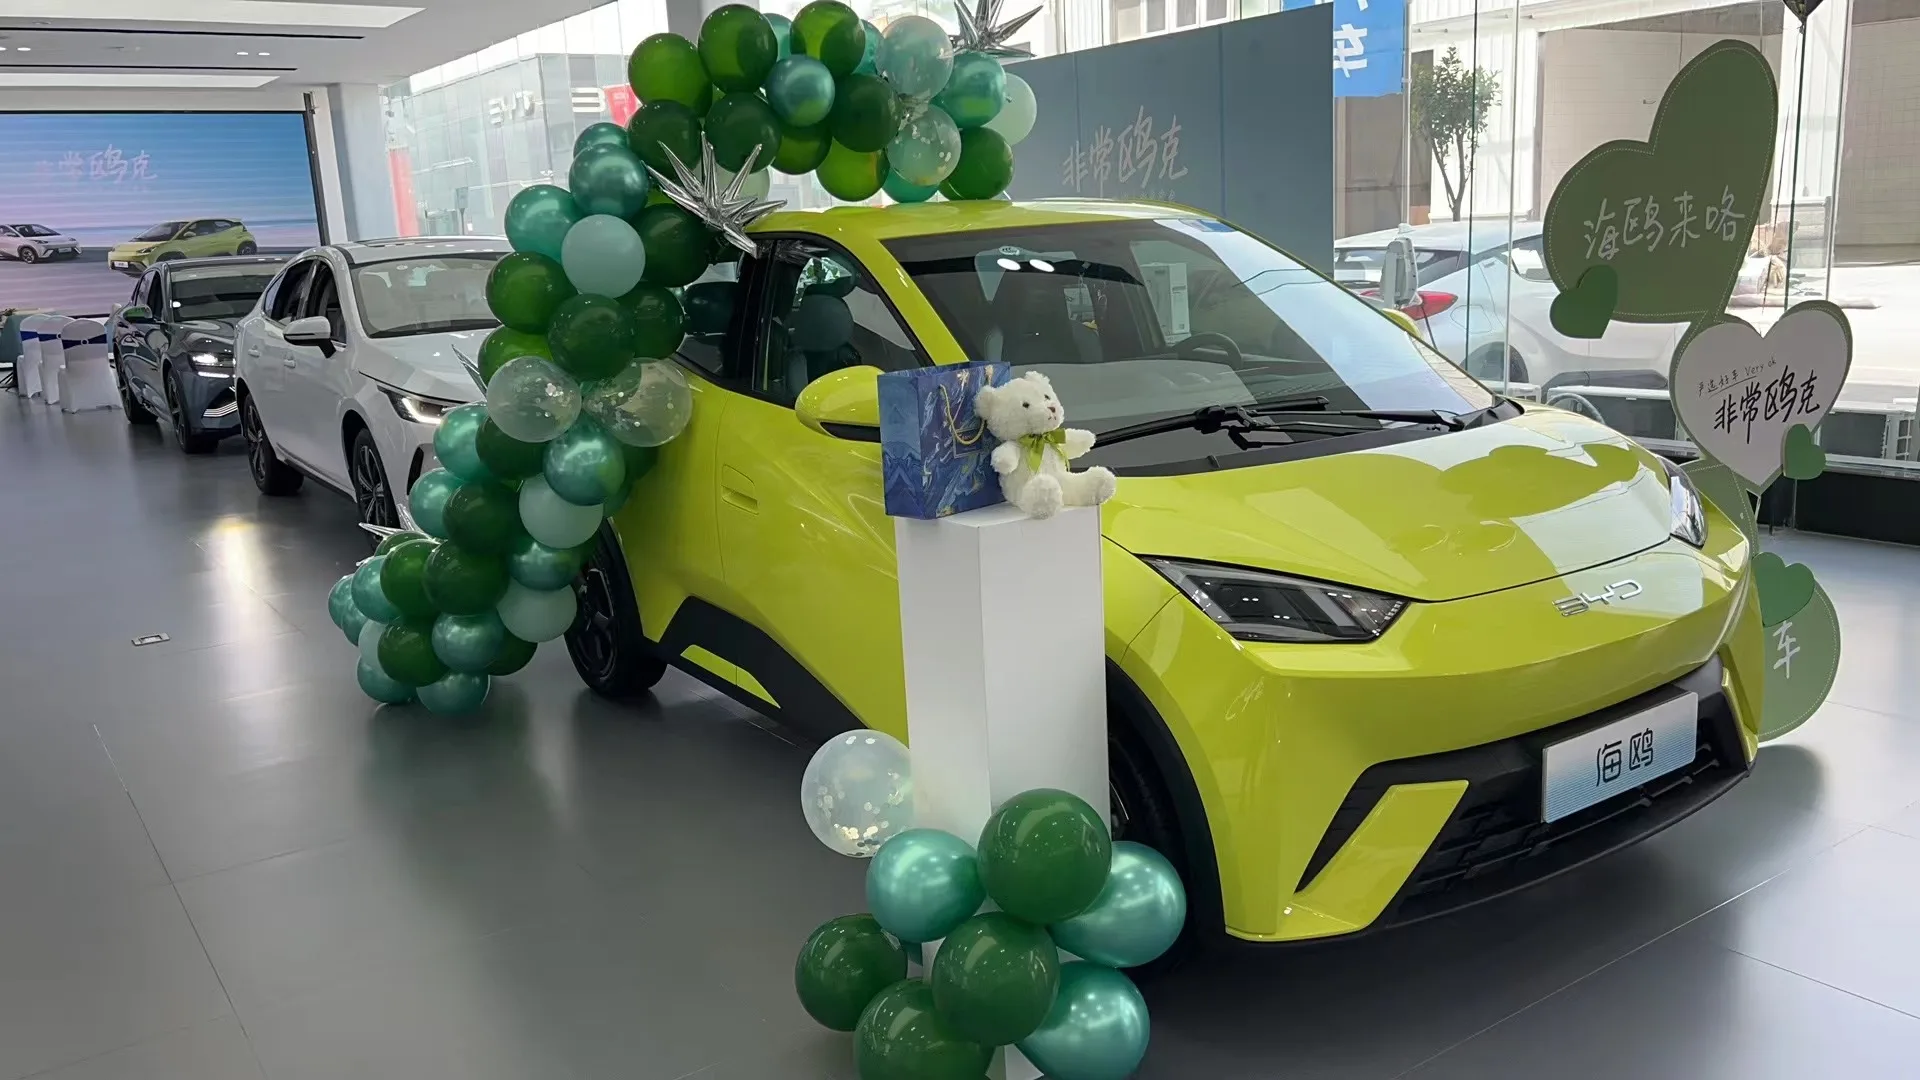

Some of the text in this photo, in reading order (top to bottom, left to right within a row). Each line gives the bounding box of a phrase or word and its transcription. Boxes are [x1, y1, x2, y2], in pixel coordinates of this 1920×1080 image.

[36, 143, 158, 184] 常鸥克
[1062, 105, 1188, 197] 非常鸥克
[1583, 185, 1746, 260] 海鸥来咯
[1744, 363, 1765, 377] Very
[1713, 365, 1820, 445] 非常鸥克
[1551, 579, 1643, 617] BYD
[1595, 728, 1654, 787] 海鸥
